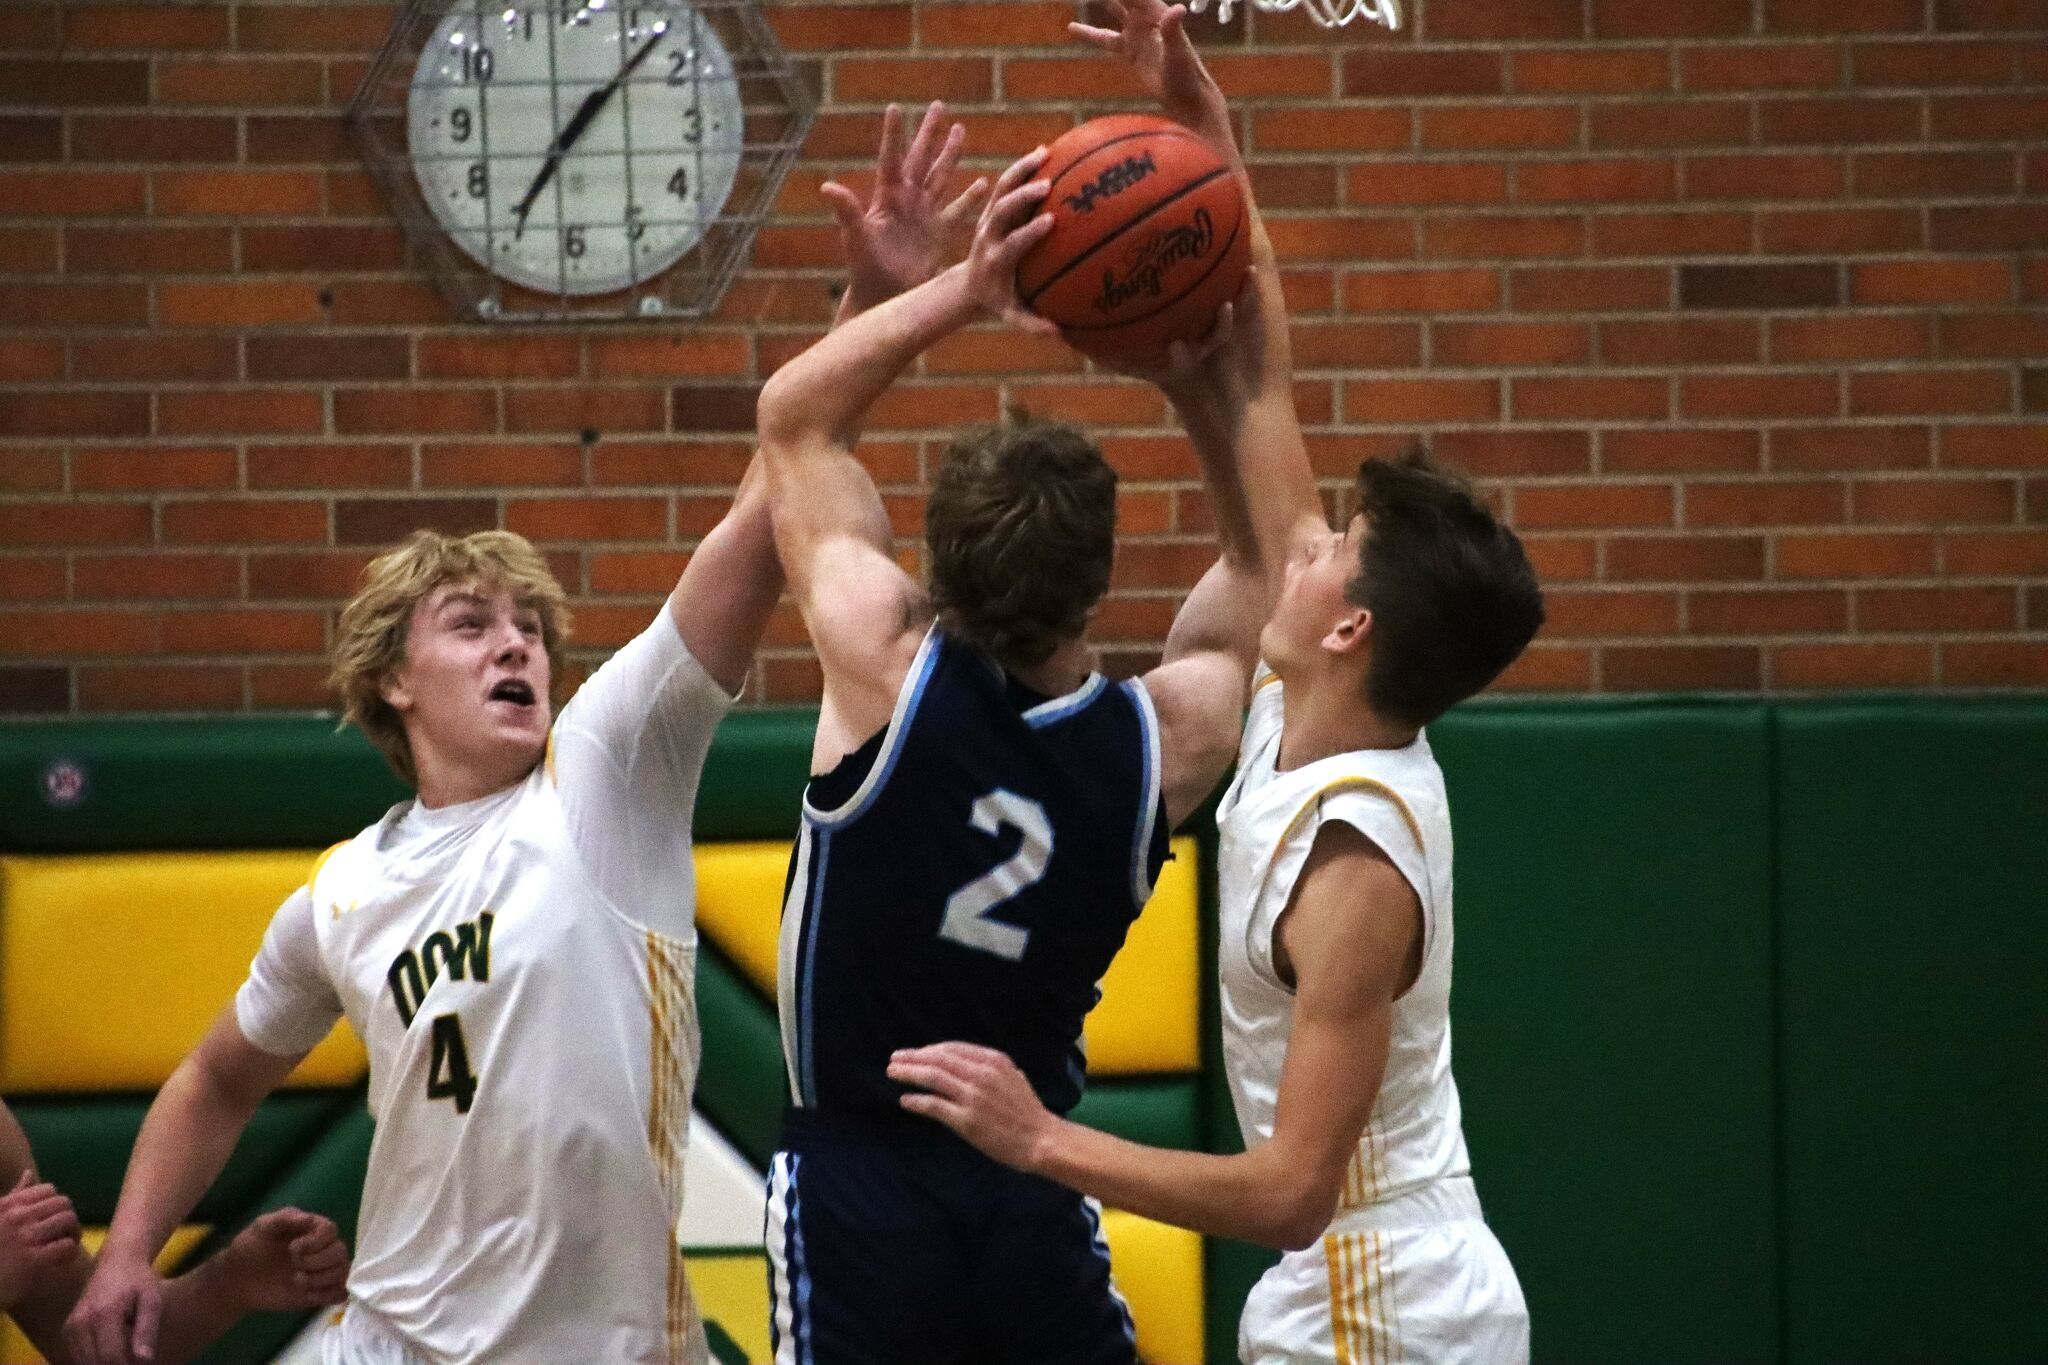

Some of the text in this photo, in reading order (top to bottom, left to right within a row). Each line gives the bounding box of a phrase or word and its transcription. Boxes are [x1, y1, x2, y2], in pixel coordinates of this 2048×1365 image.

[462, 47, 494, 83] 10
[667, 48, 687, 87] 2
[450, 107, 471, 143] 9
[683, 108, 702, 143] 3
[467, 164, 489, 199] 8
[666, 167, 688, 200] 4
[565, 224, 586, 259] 6
[624, 206, 646, 241] 5
[939, 785, 1055, 963] 2
[387, 910, 496, 1030] DOW
[426, 1011, 478, 1115] 4
